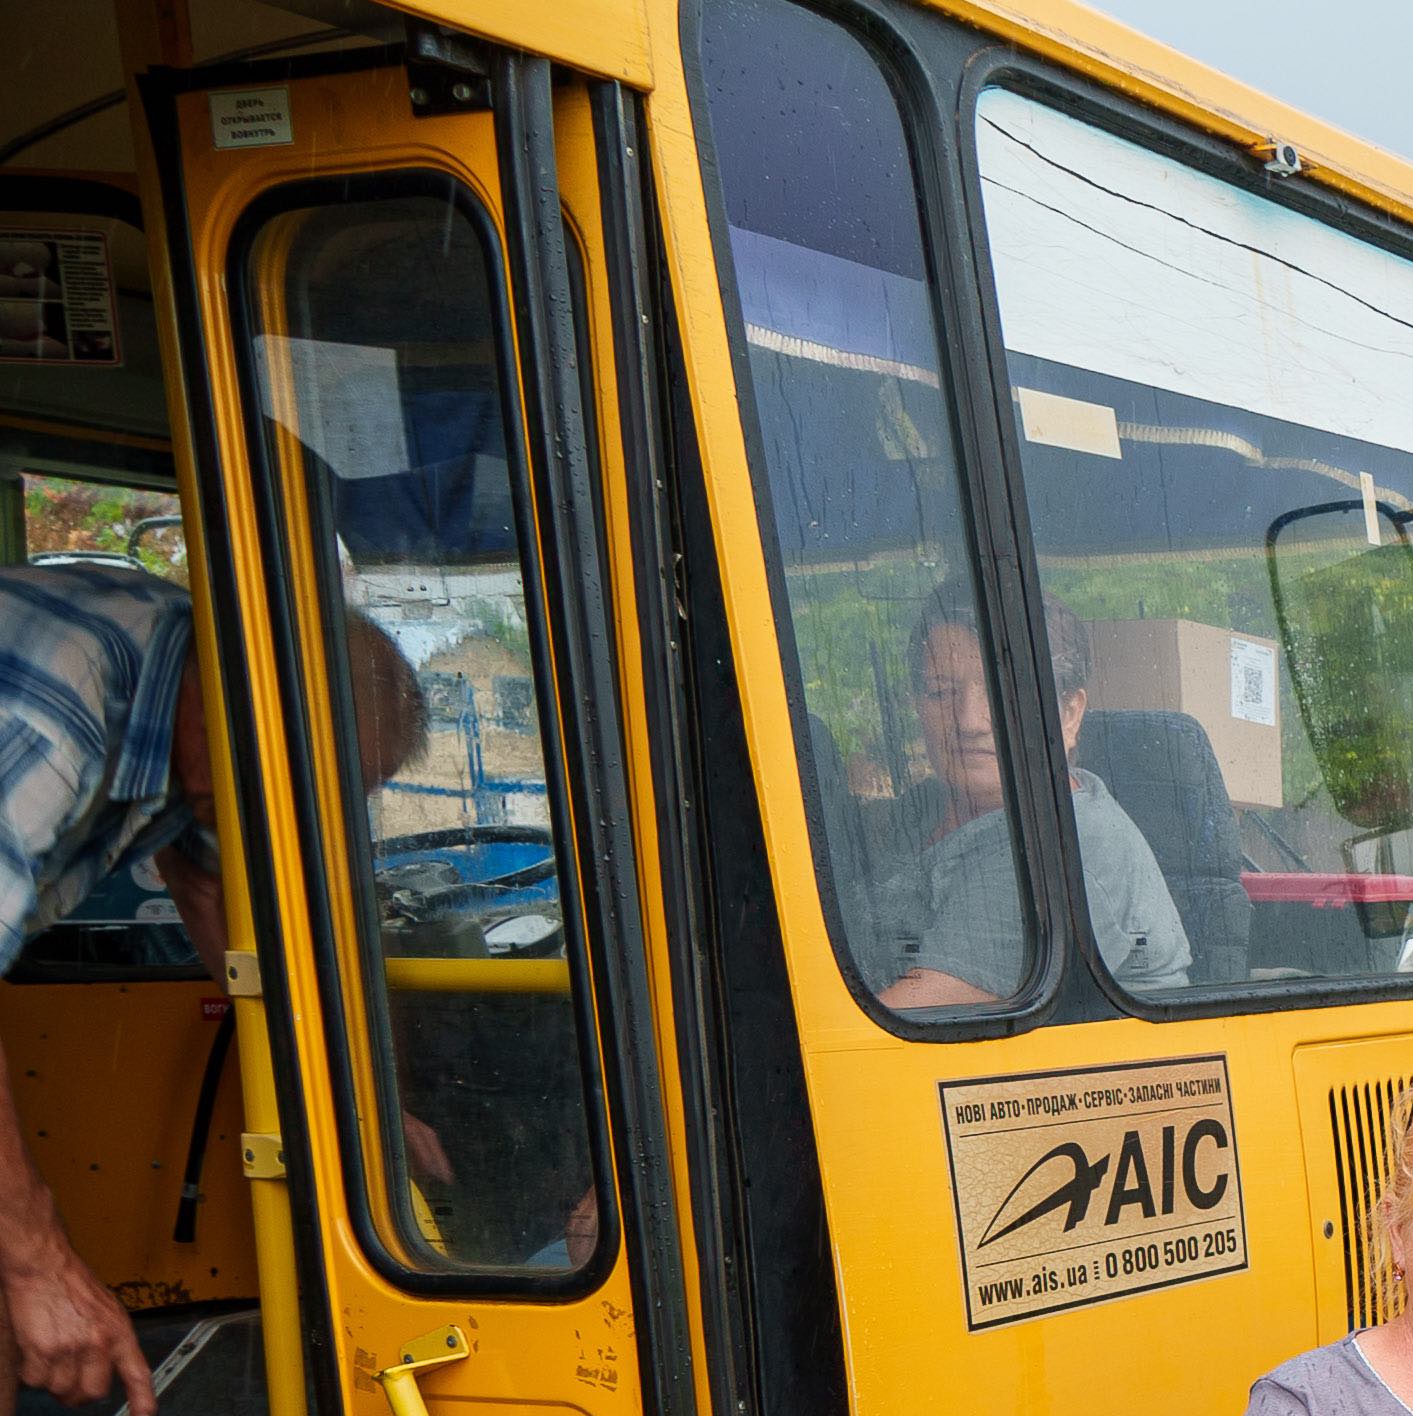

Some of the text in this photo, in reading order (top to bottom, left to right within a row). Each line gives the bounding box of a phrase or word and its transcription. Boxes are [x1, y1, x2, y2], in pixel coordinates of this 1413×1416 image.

[955, 1103, 986, 1124] НОВІ
[1175, 1078, 1221, 1098] ЧАСТИНИ
[978, 1229, 1238, 1306] www.ais.ua 0 800 500 205
